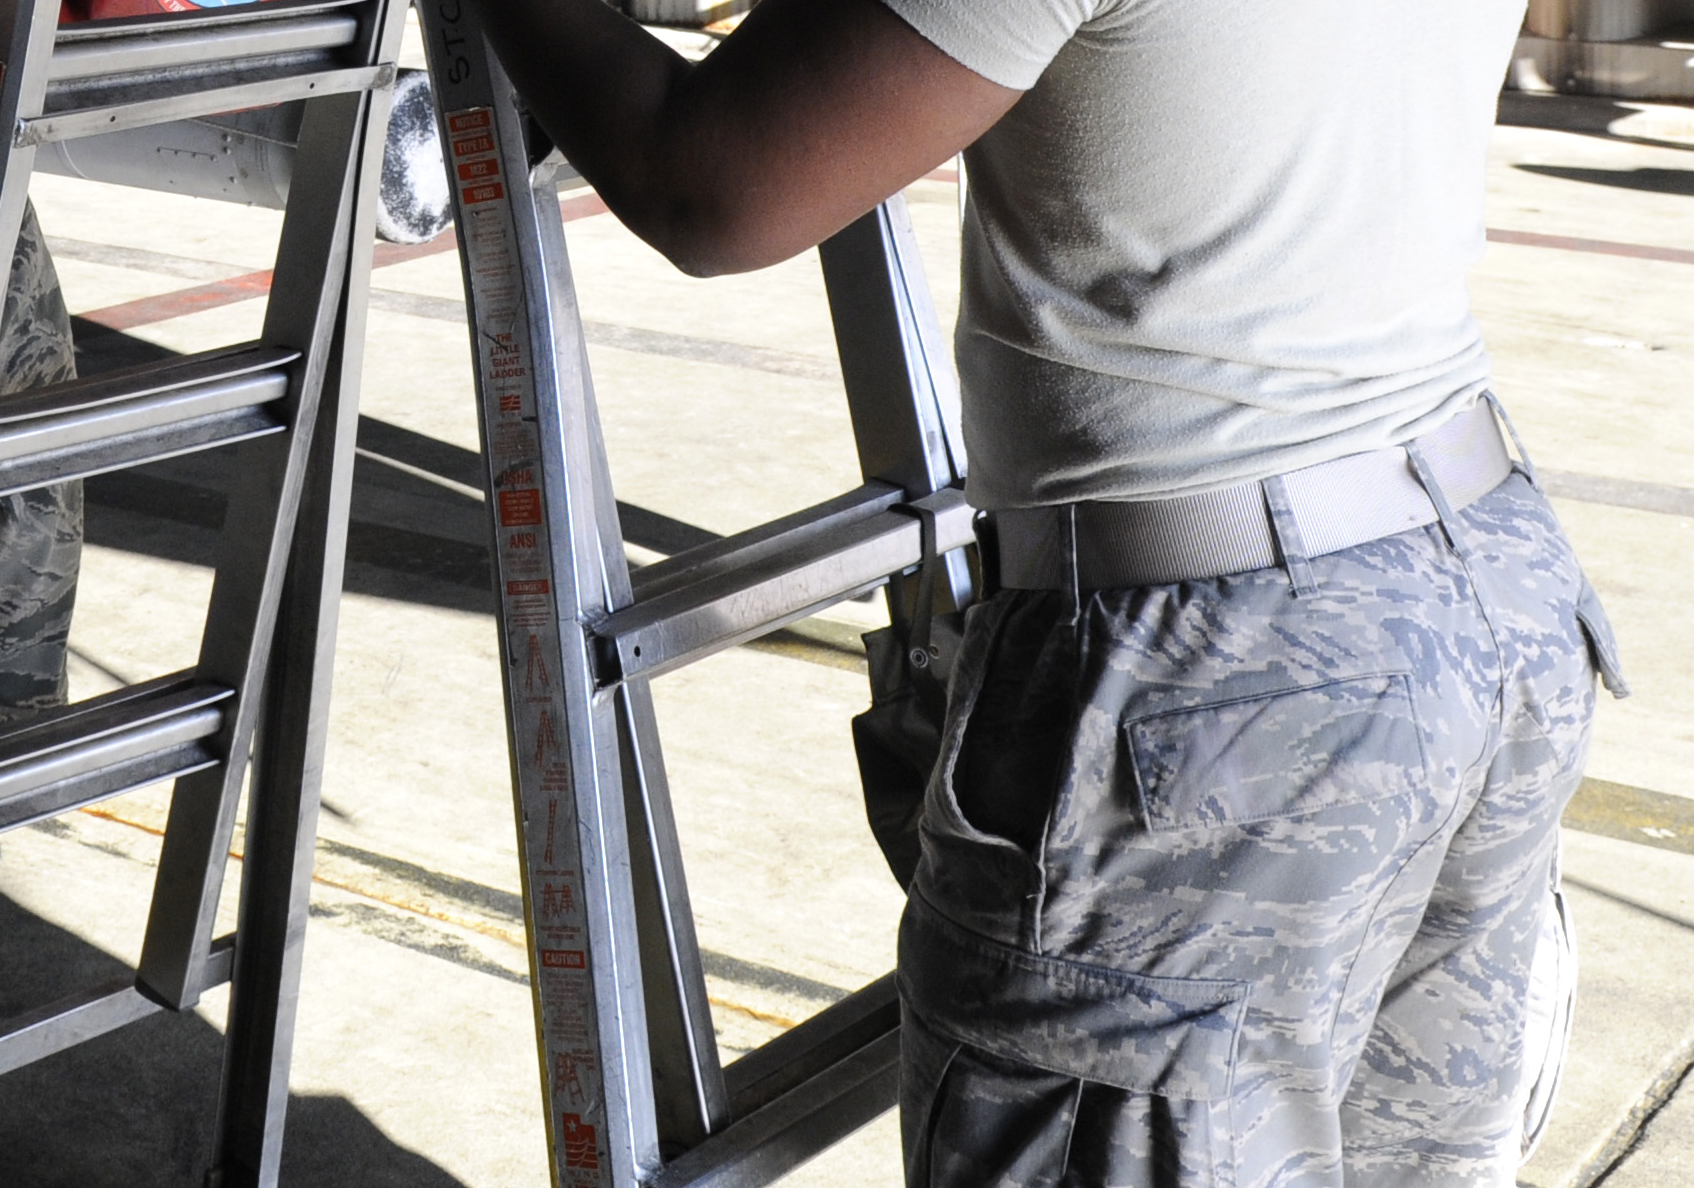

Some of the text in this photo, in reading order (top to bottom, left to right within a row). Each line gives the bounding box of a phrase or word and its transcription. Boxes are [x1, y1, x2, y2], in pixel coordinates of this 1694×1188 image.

[495, 332, 513, 342] THE
[491, 356, 520, 368] GIANT
[489, 367, 526, 380] LADDER
[509, 532, 537, 550] ANSI
[545, 951, 581, 966] CAUTION
